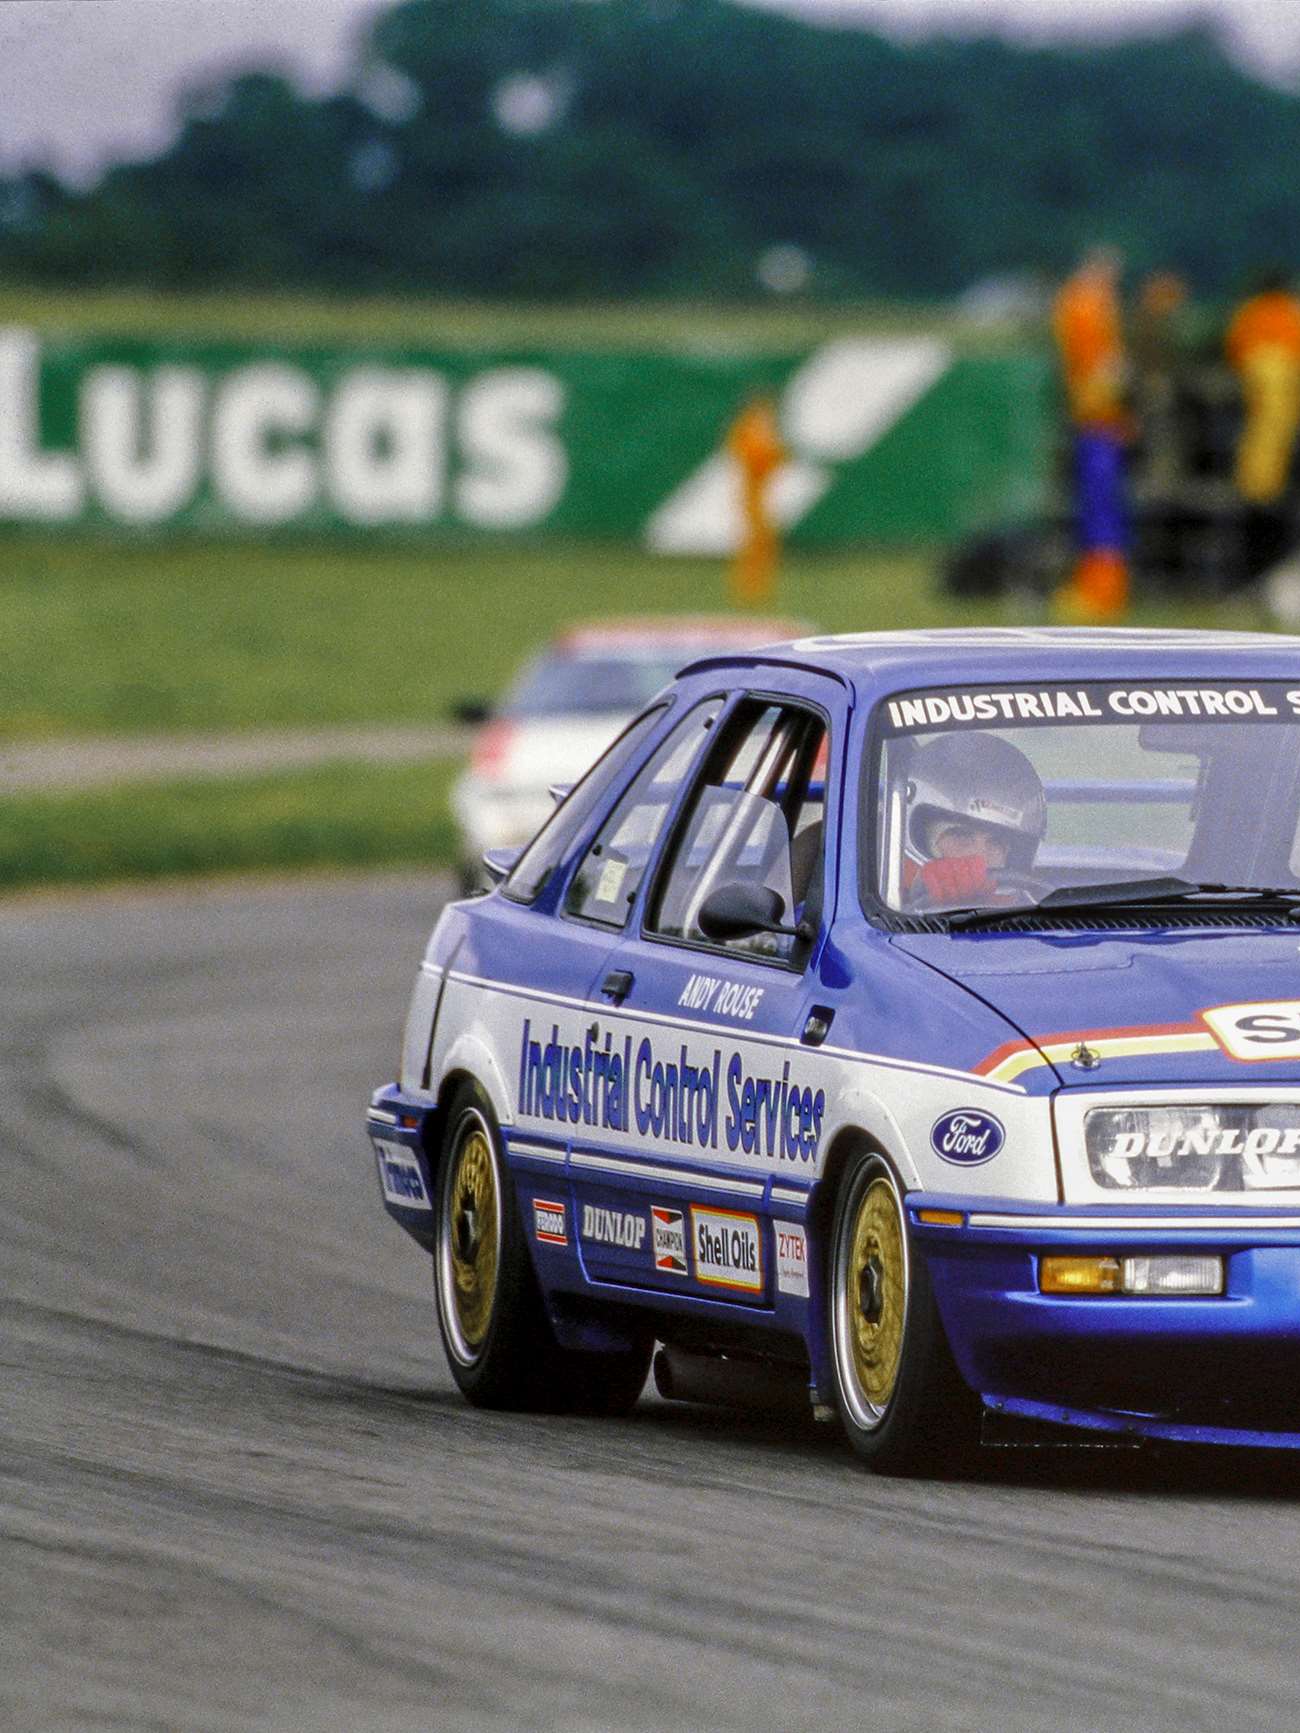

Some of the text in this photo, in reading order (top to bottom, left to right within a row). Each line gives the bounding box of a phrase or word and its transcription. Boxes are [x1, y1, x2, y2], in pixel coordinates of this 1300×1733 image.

[0, 325, 568, 530] Lucas
[888, 690, 1102, 728] INDUSTRIAL
[1108, 689, 1277, 715] CONTROL
[678, 973, 765, 1020] ANDY ROUSE
[518, 1018, 825, 1162] Industrial Control Services
[943, 1115, 991, 1155] Ford
[583, 1204, 646, 1249] DUNLOP
[699, 1223, 756, 1271] Shell Oils
[779, 1233, 806, 1262] ZYTEK
